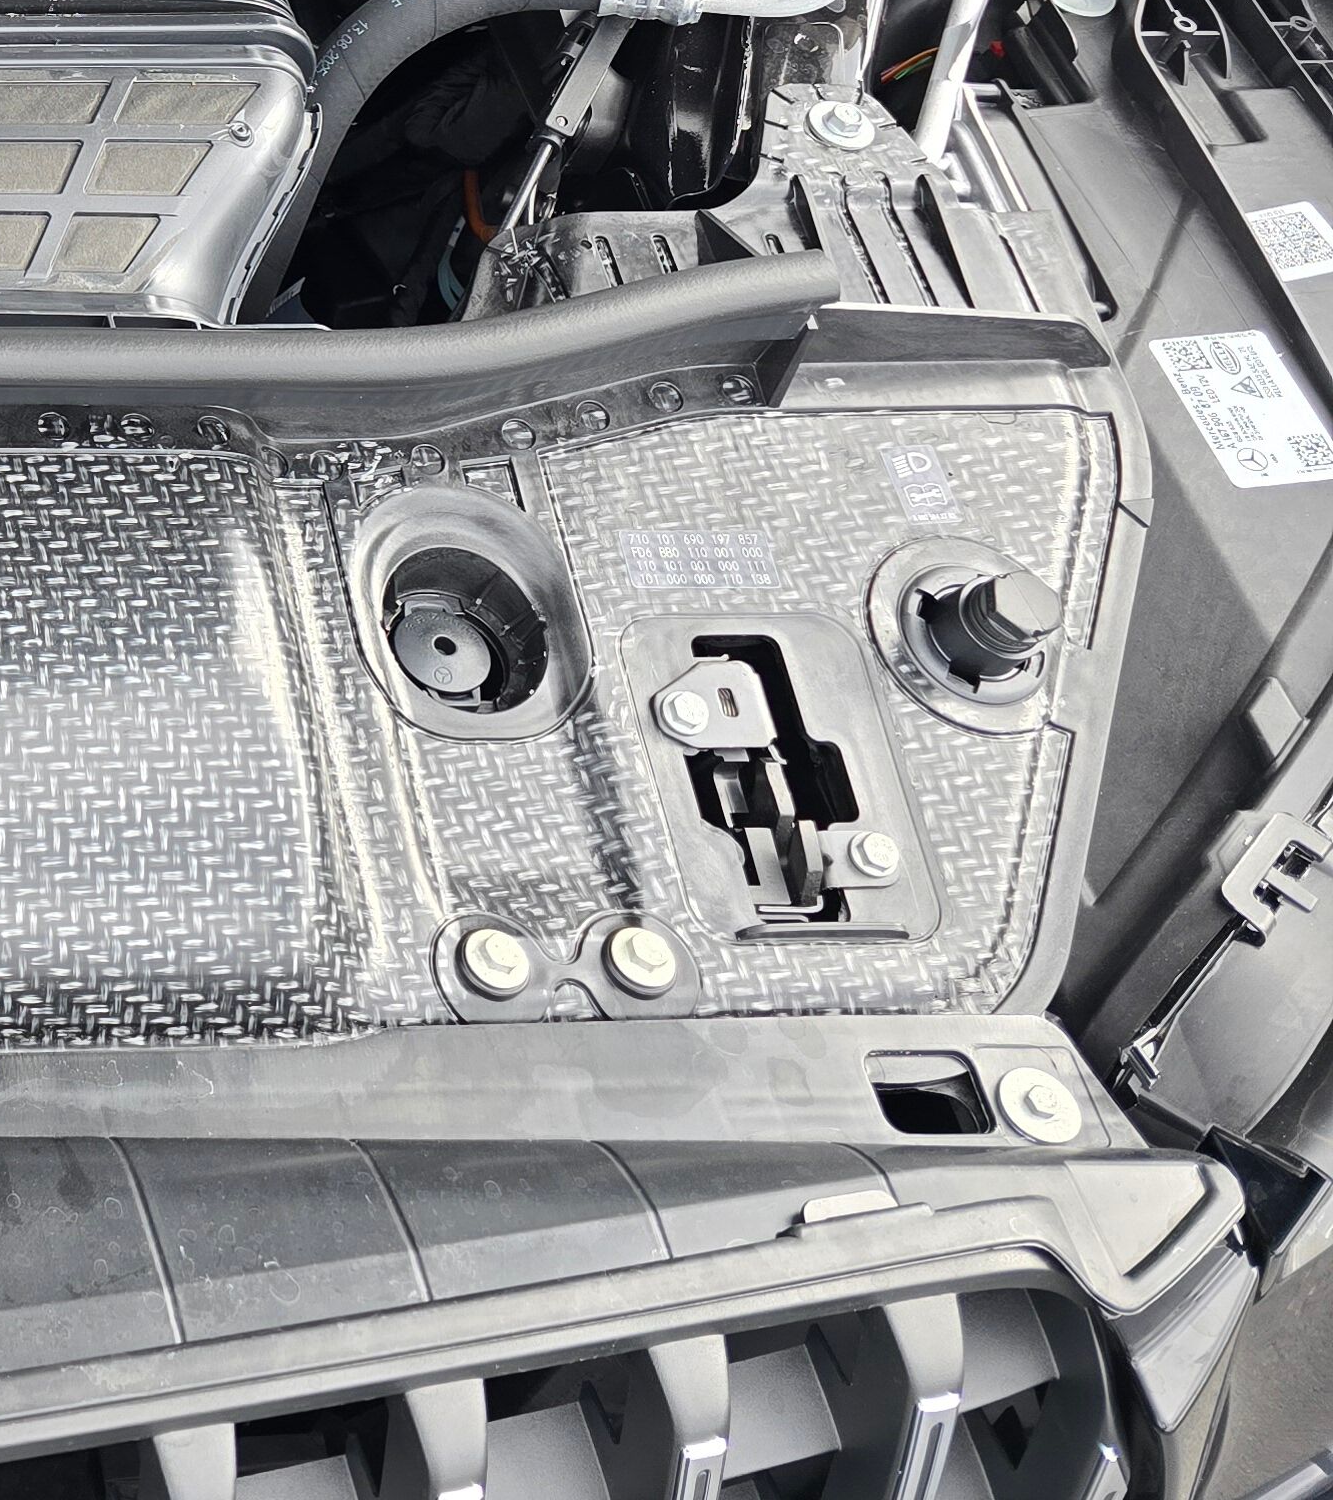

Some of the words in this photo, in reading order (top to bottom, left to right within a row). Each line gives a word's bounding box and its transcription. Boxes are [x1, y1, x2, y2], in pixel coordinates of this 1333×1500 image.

[1211, 341, 1237, 372] HELLA
[1173, 372, 1192, 394] Benz
[1192, 404, 1225, 450] Mercedes
[628, 534, 650, 545] 710
[656, 533, 676, 545] 101
[683, 533, 704, 545] 690
[711, 533, 731, 545] 197
[737, 533, 758, 545] 857
[688, 547, 708, 558] 110
[714, 547, 734, 558] 001
[742, 547, 763, 558] 000
[637, 560, 657, 572] 110
[664, 560, 683, 572] 101
[690, 560, 711, 572] 001
[718, 560, 739, 572] 000
[748, 560, 767, 572] 111
[640, 573, 659, 585] 101
[666, 573, 687, 585] 000
[694, 573, 715, 585] 000
[724, 573, 743, 585] 110
[751, 573, 772, 585] 138
